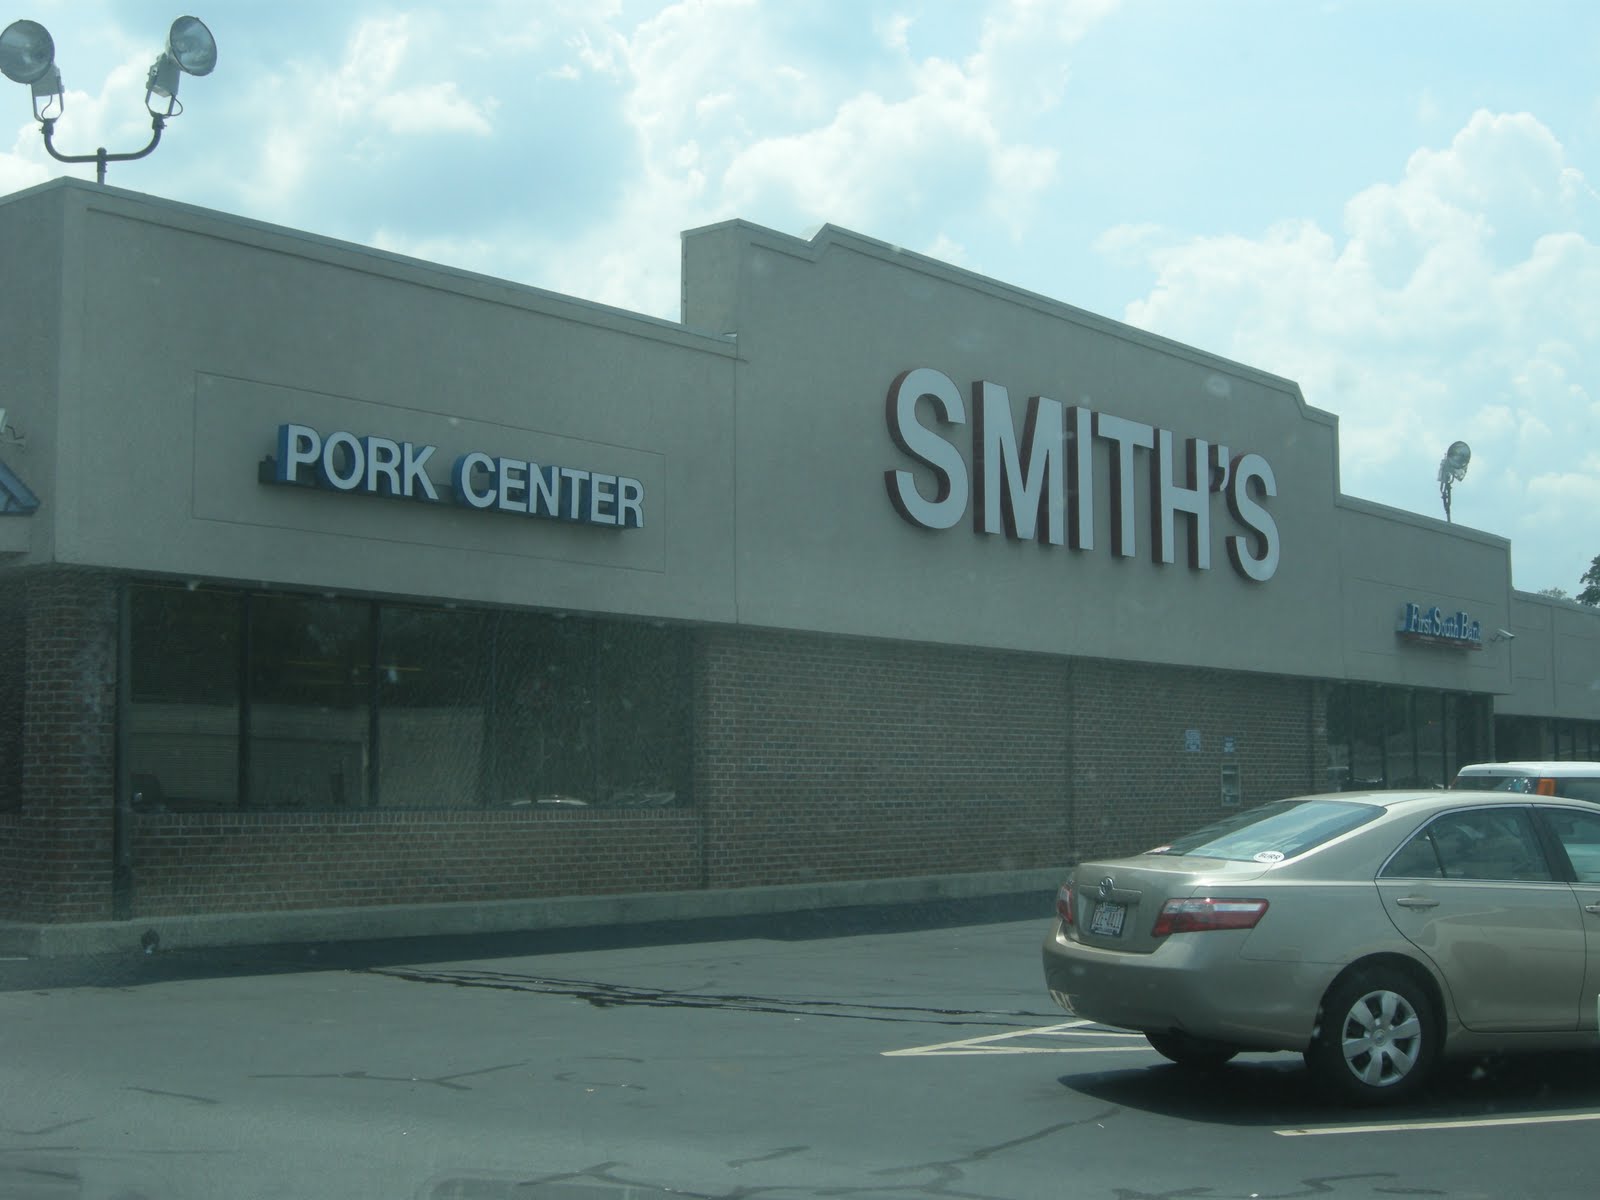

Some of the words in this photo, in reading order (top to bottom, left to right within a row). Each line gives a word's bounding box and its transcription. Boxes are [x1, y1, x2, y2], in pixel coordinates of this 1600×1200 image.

[281, 423, 439, 501] PORK
[456, 451, 645, 529] CENTER
[887, 367, 1281, 582] SMITH'S
